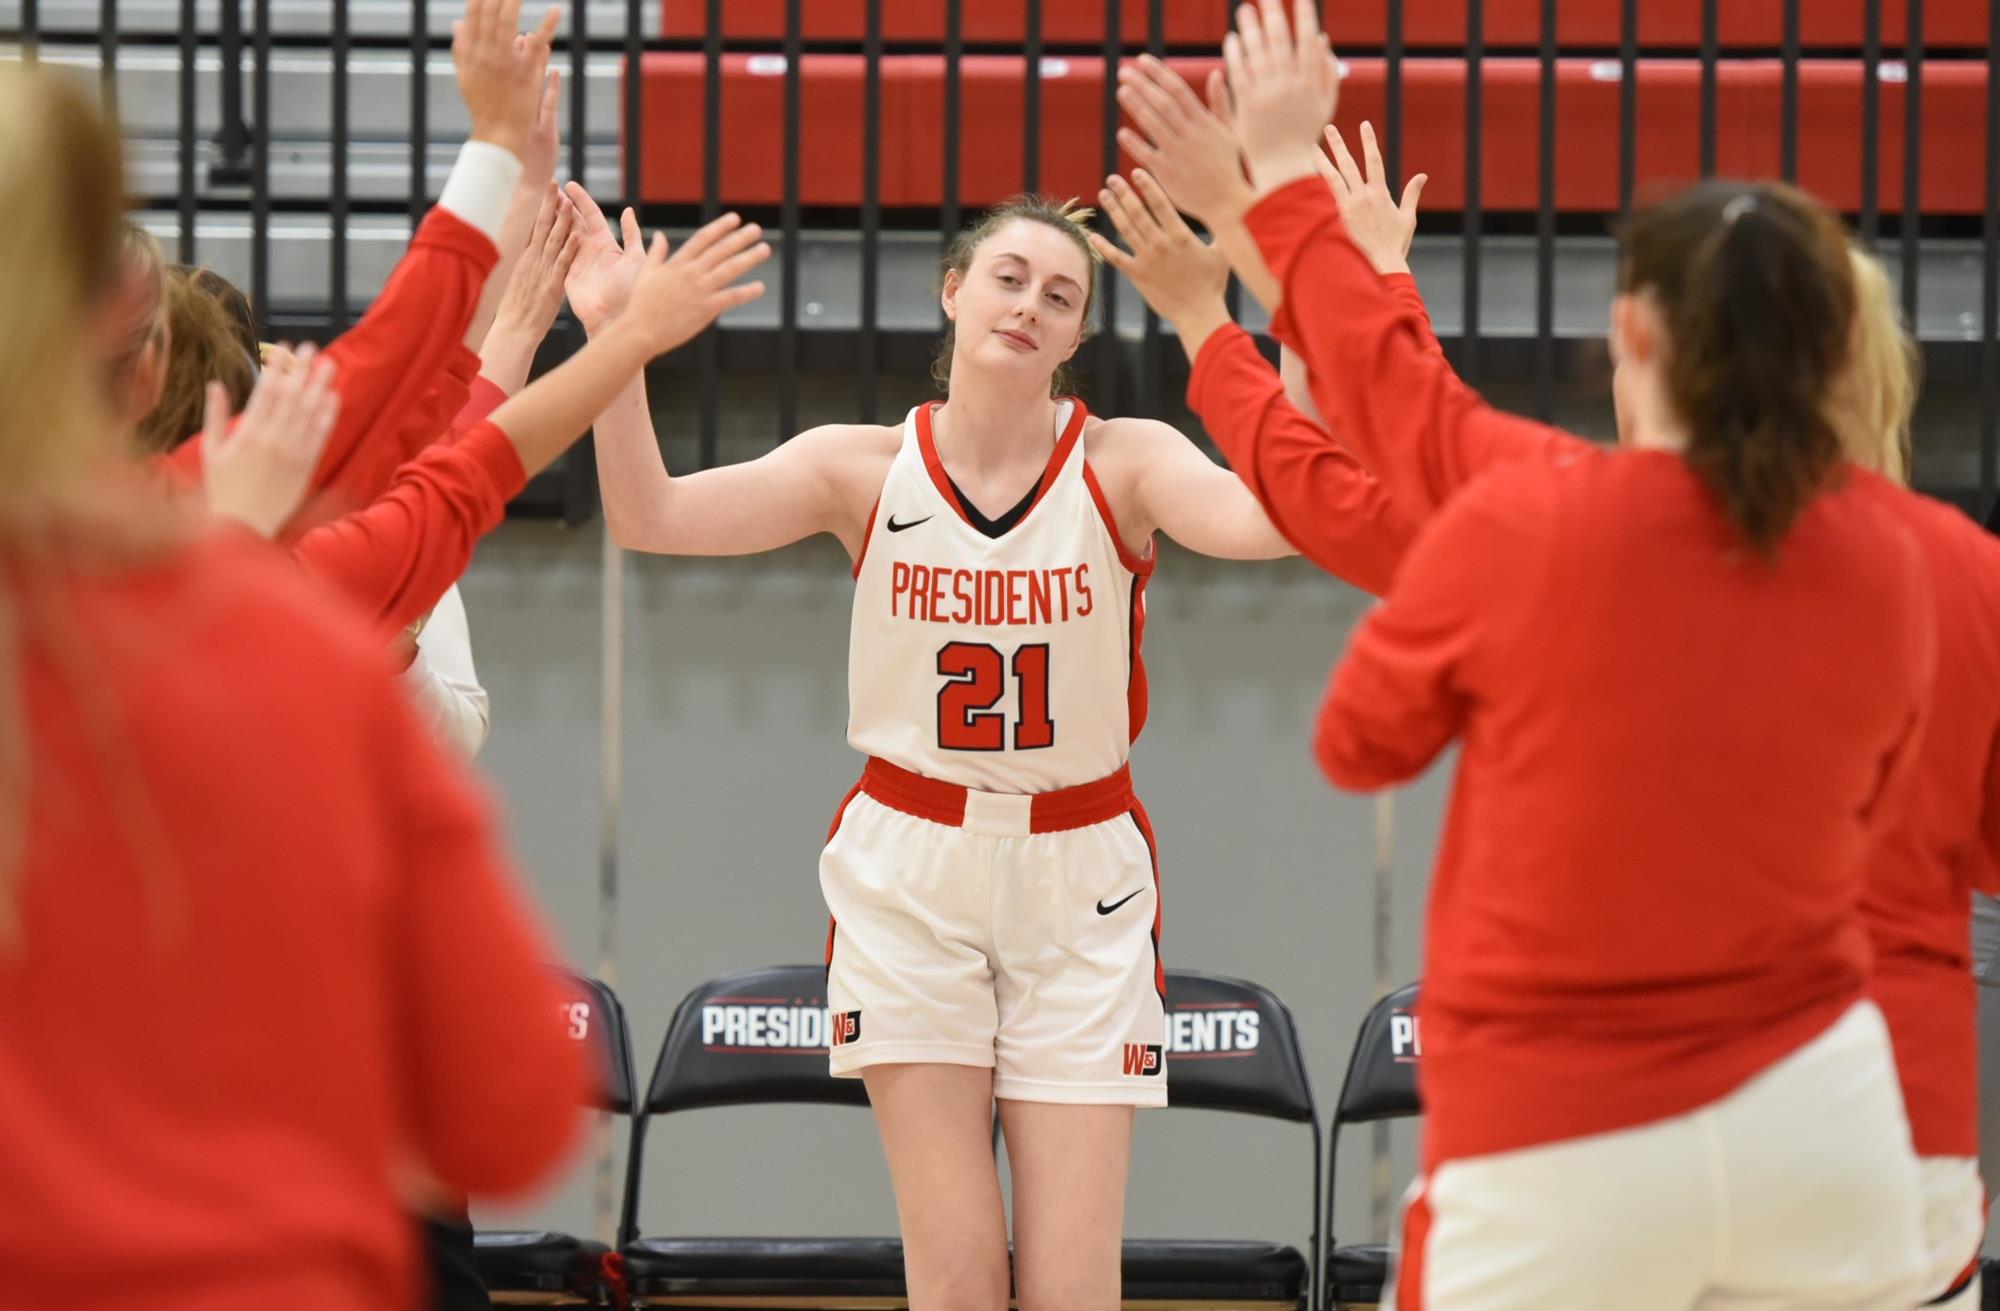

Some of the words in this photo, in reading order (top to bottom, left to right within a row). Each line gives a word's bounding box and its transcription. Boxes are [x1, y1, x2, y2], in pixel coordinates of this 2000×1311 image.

[891, 561, 1093, 625] PRESIDENTS
[937, 641, 1054, 751] 21
[1122, 1043, 1162, 1076] W&J
